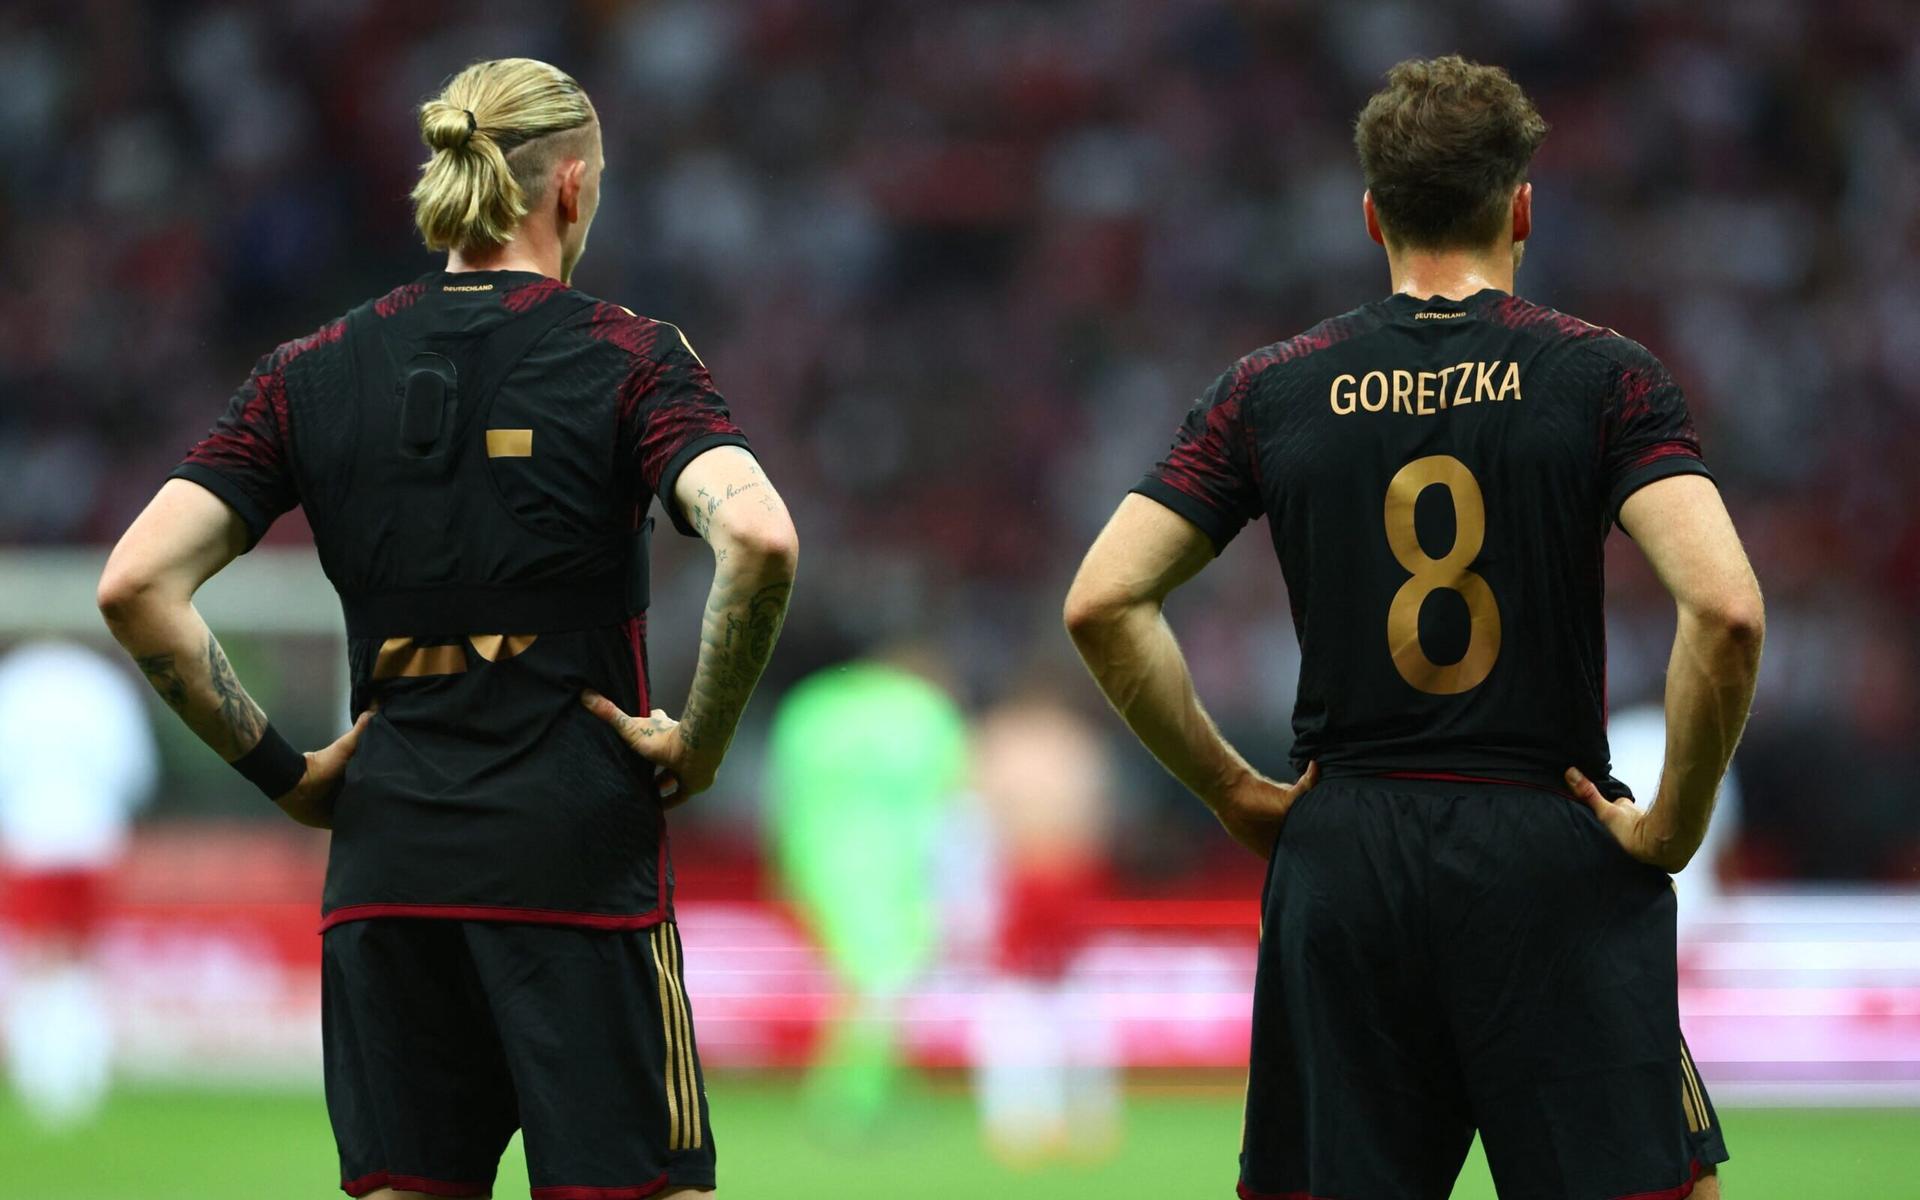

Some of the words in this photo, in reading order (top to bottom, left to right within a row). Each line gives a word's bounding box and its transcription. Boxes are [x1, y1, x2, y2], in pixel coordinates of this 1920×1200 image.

[443, 284, 493, 292] DEUTSCHLAND
[1415, 312, 1466, 320] DEUTSCHLAND
[1330, 361, 1521, 415] GORETZKA
[1384, 455, 1501, 695] 8
